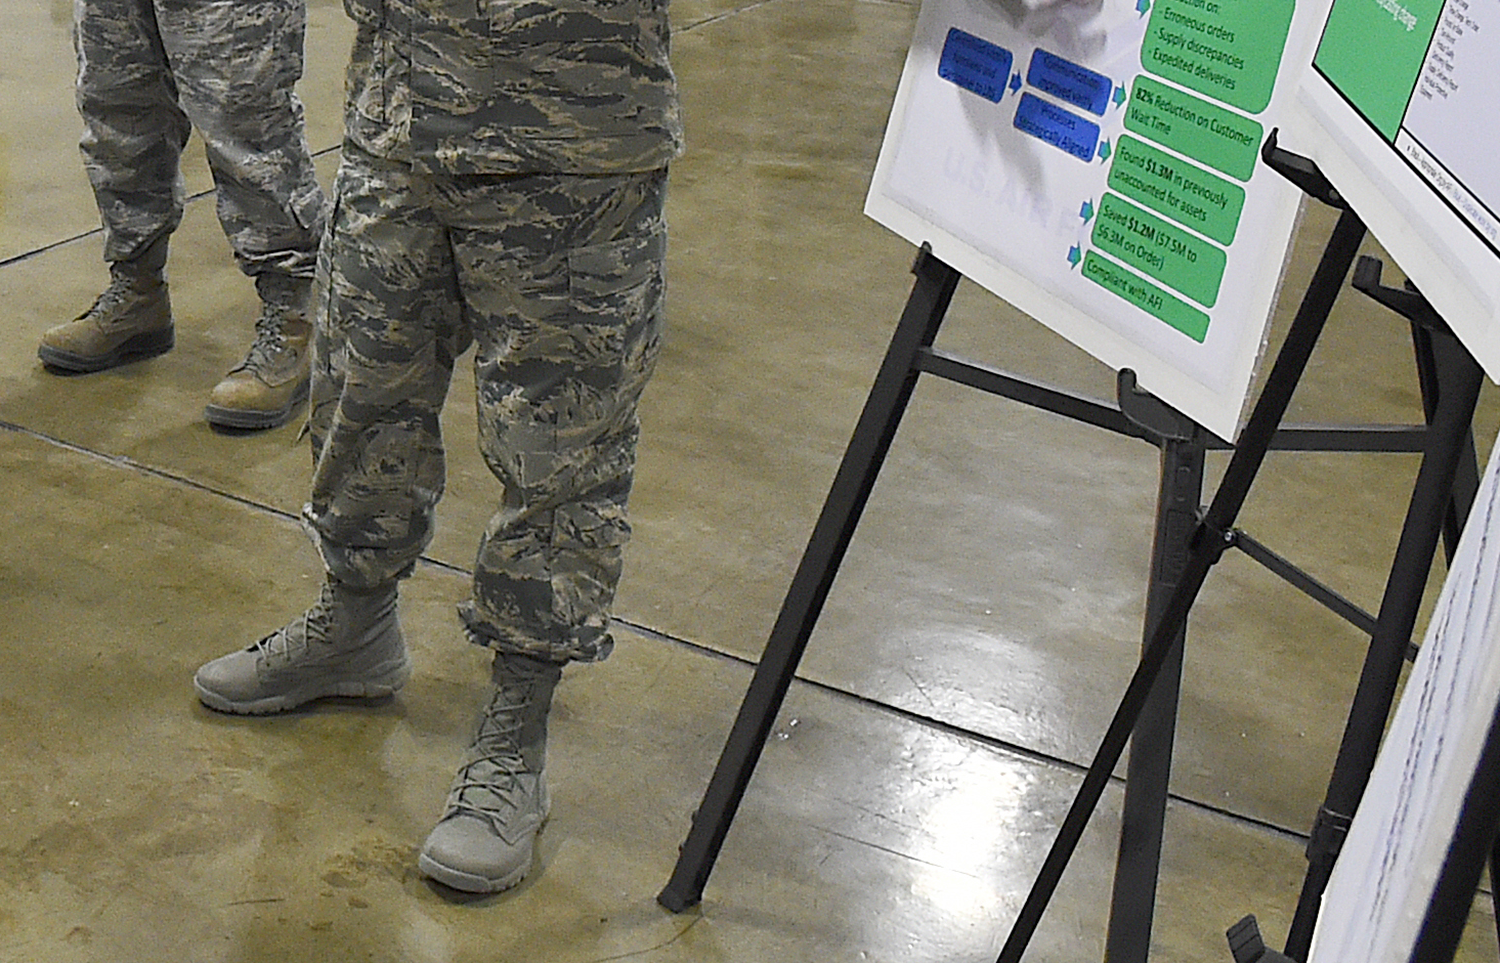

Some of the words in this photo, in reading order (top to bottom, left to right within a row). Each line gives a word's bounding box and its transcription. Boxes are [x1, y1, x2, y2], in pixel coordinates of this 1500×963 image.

[1158, 27, 1185, 50] Supply
[1187, 37, 1244, 70] discrepancies
[1164, 7, 1206, 33] Erroneous
[1207, 23, 1235, 43] orders
[1153, 47, 1194, 74] Expedited
[1194, 64, 1236, 90] deliveries
[1131, 106, 1149, 126] Wait
[1151, 115, 1172, 135] Time
[1135, 87, 1153, 106] 82%
[1154, 95, 1196, 123] Reduction
[1197, 114, 1209, 129] on
[1210, 119, 1254, 146] Customer
[1114, 169, 1166, 201] unaccounted
[1166, 192, 1181, 208] for
[1179, 200, 1207, 222] assets
[1121, 146, 1145, 169] Found
[1145, 158, 1173, 182] $1.3M
[1174, 174, 1183, 186] in
[1183, 178, 1228, 211] previously
[1098, 224, 1123, 249] $6.3M
[1124, 240, 1136, 254] on
[1136, 245, 1165, 271] Order)
[1103, 204, 1128, 228] Saved
[1127, 218, 1155, 243] $1.2M
[1187, 247, 1198, 263] to
[1087, 259, 1127, 292] Compliant
[1127, 278, 1147, 300] with
[1148, 292, 1163, 311] AFI
